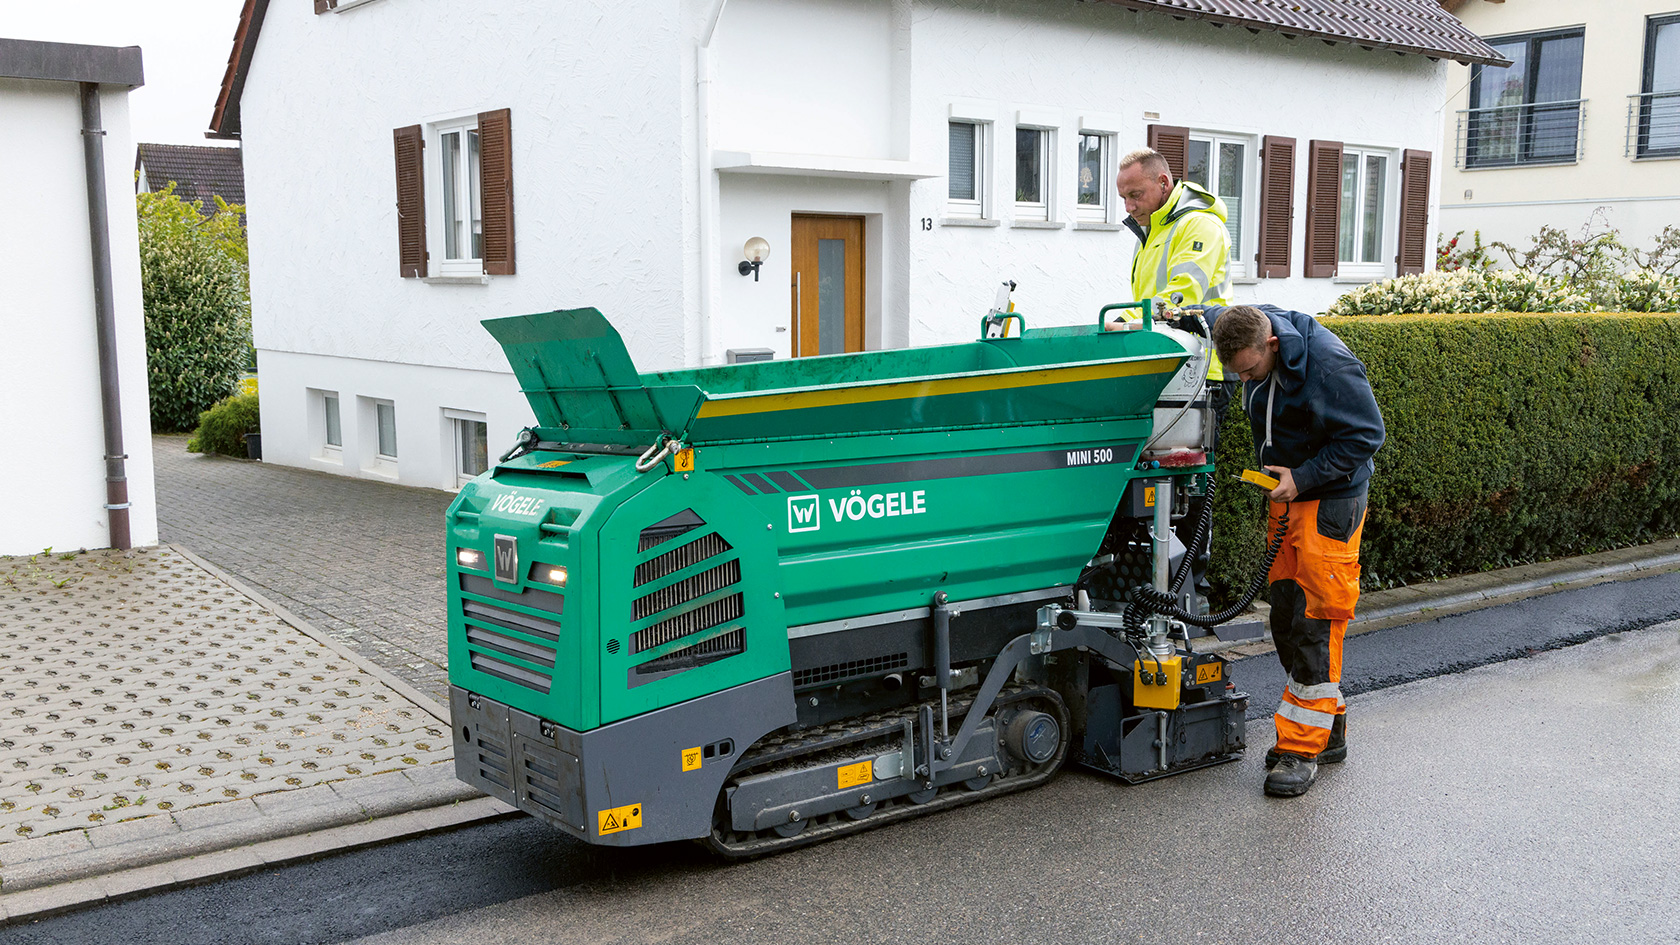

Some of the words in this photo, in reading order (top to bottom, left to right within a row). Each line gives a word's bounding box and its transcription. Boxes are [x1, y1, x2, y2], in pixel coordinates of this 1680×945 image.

[920, 217, 933, 231] 13
[1066, 450, 1091, 466] MINI
[1093, 448, 1113, 463] 500
[491, 490, 544, 515] VÖGELE
[828, 489, 926, 522] VÖGELE
